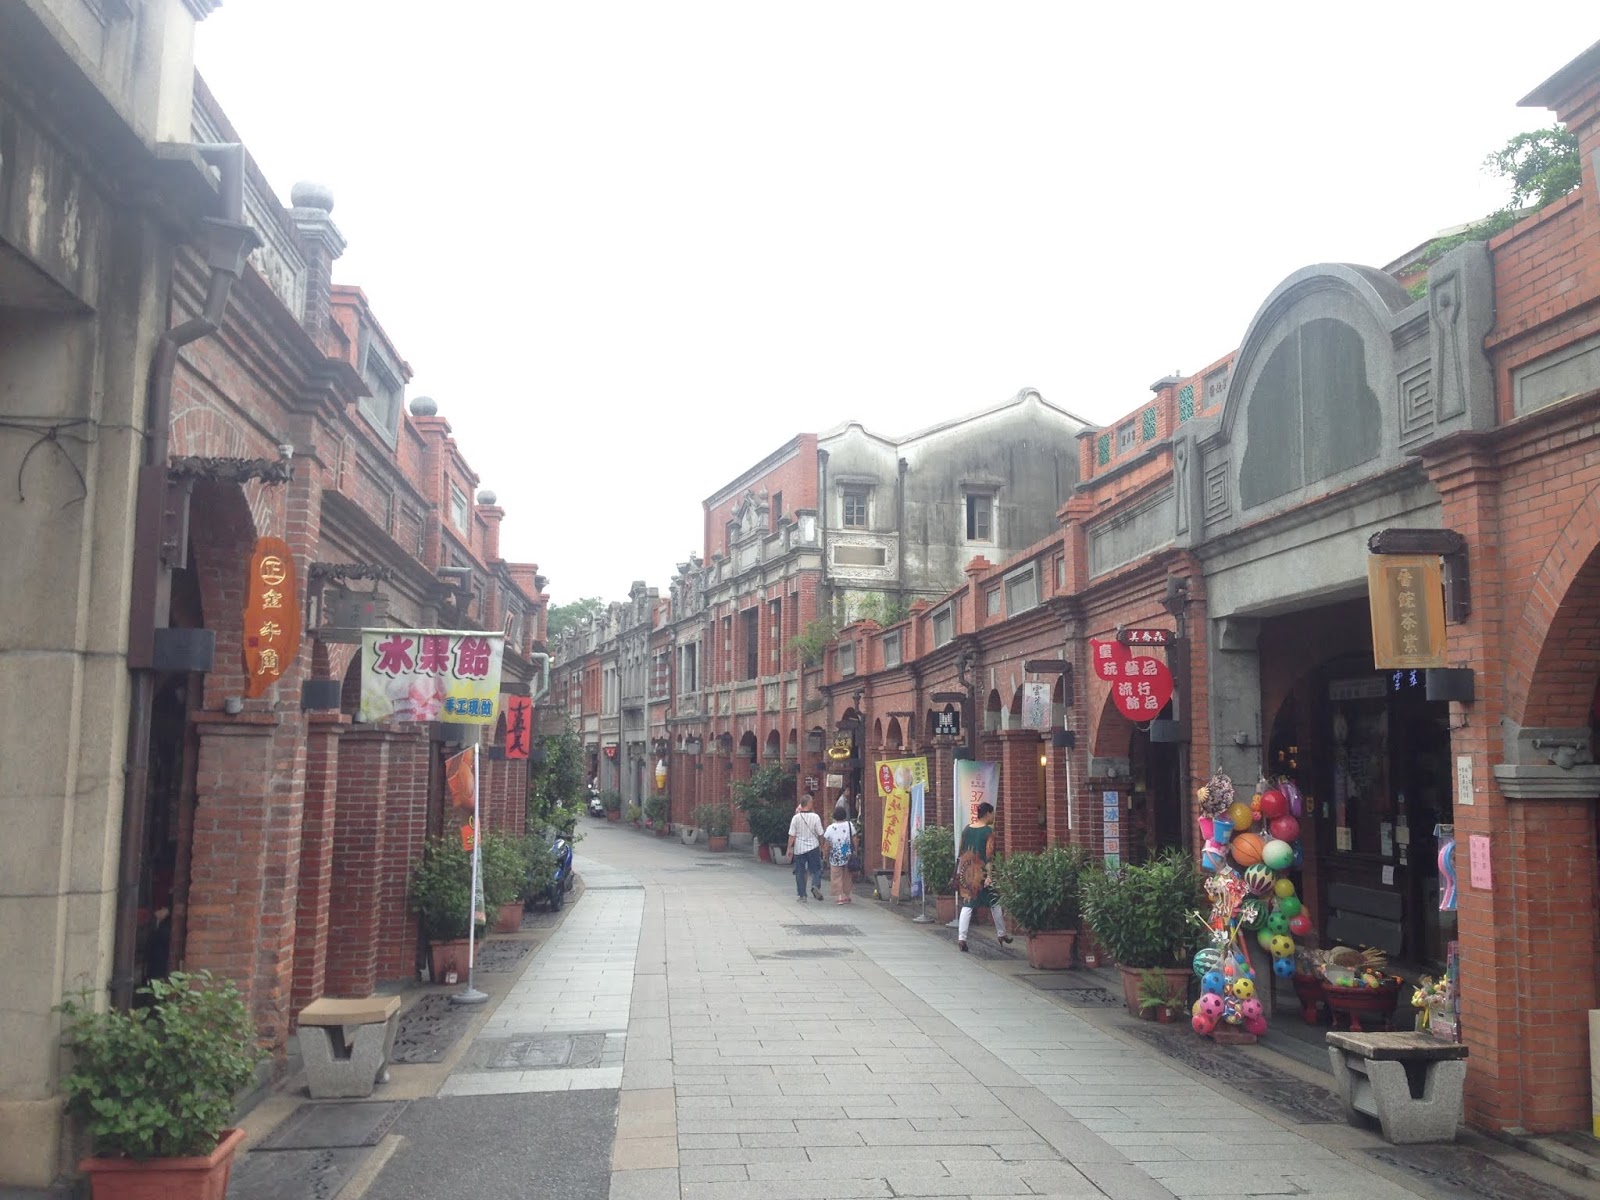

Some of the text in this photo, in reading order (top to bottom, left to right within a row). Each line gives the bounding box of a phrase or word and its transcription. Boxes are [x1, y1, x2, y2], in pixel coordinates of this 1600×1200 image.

[378, 634, 491, 676] 水果飴
[1119, 682, 1151, 696] 流行
[1125, 695, 1158, 710] 飾品
